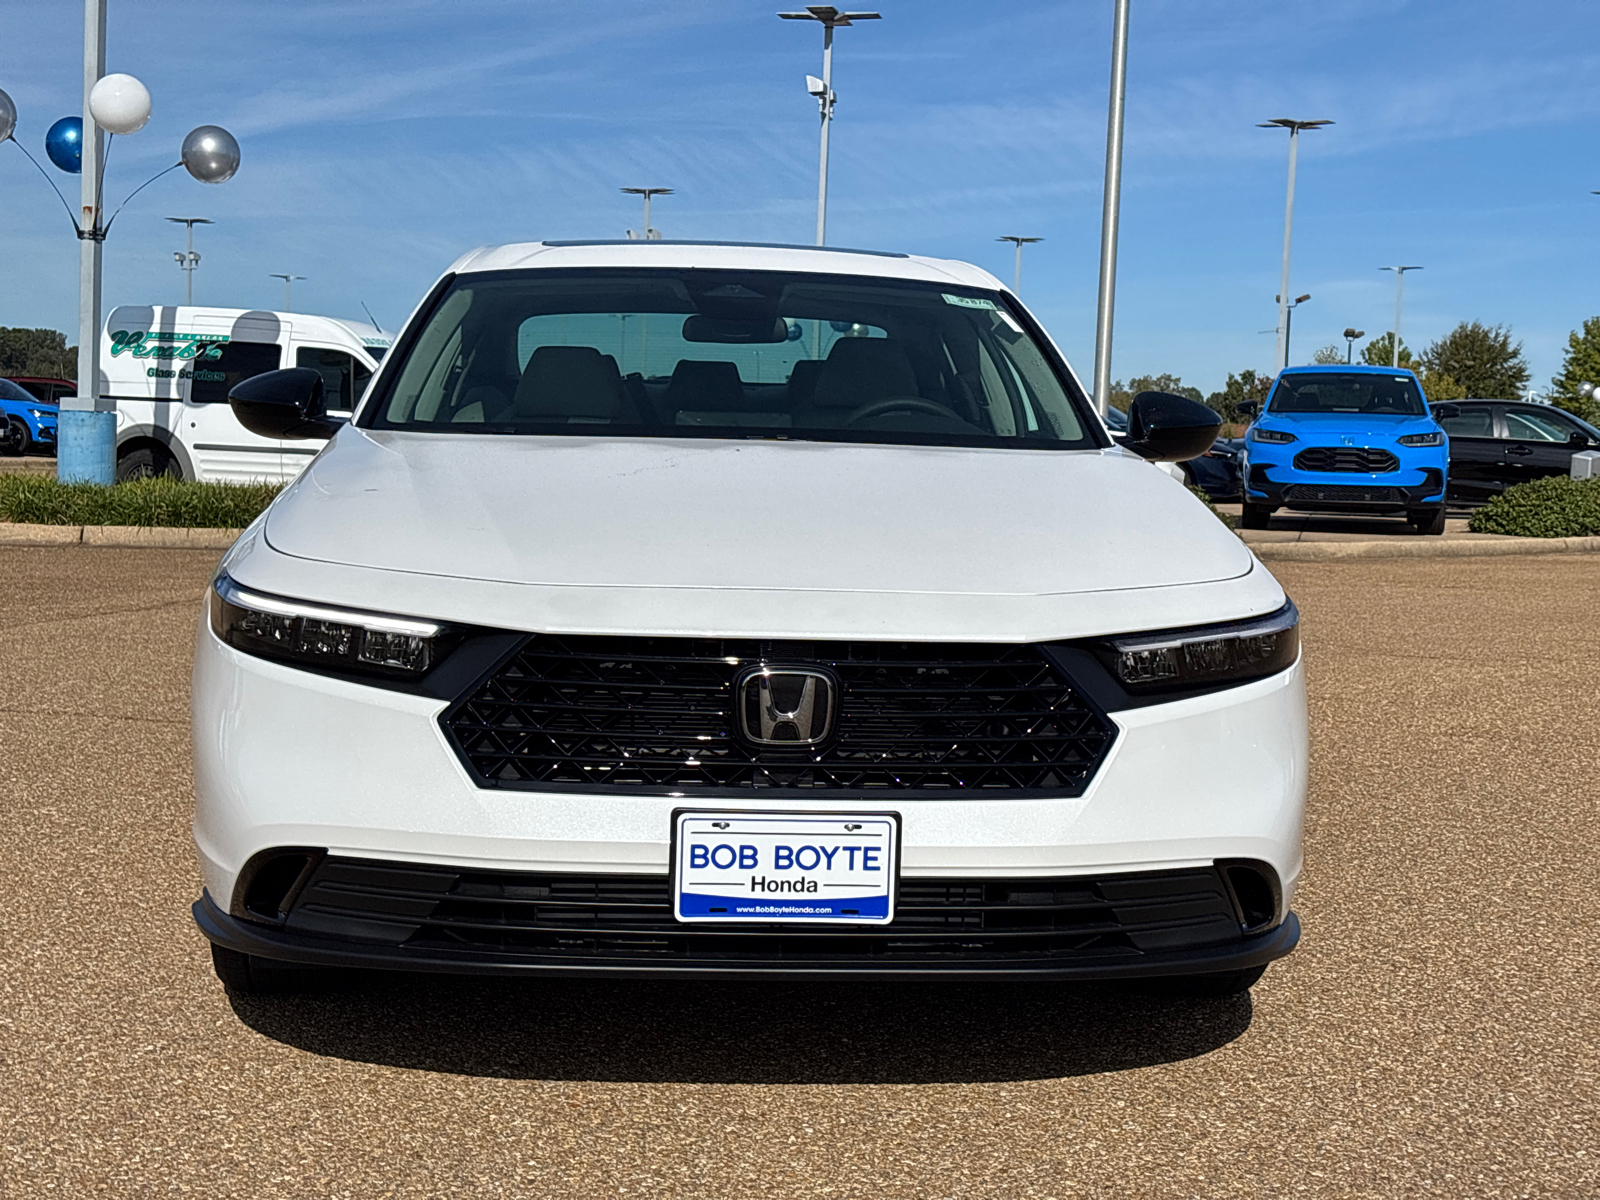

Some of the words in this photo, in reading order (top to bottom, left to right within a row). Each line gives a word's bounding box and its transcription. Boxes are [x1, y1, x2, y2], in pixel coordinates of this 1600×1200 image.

[147, 367, 176, 379] Glass
[178, 368, 226, 381] Services
[690, 844, 759, 870] BOB
[774, 845, 882, 871] BOYTE
[751, 876, 818, 893] Honda
[736, 905, 832, 915] www.BobBoyteHonda.com
